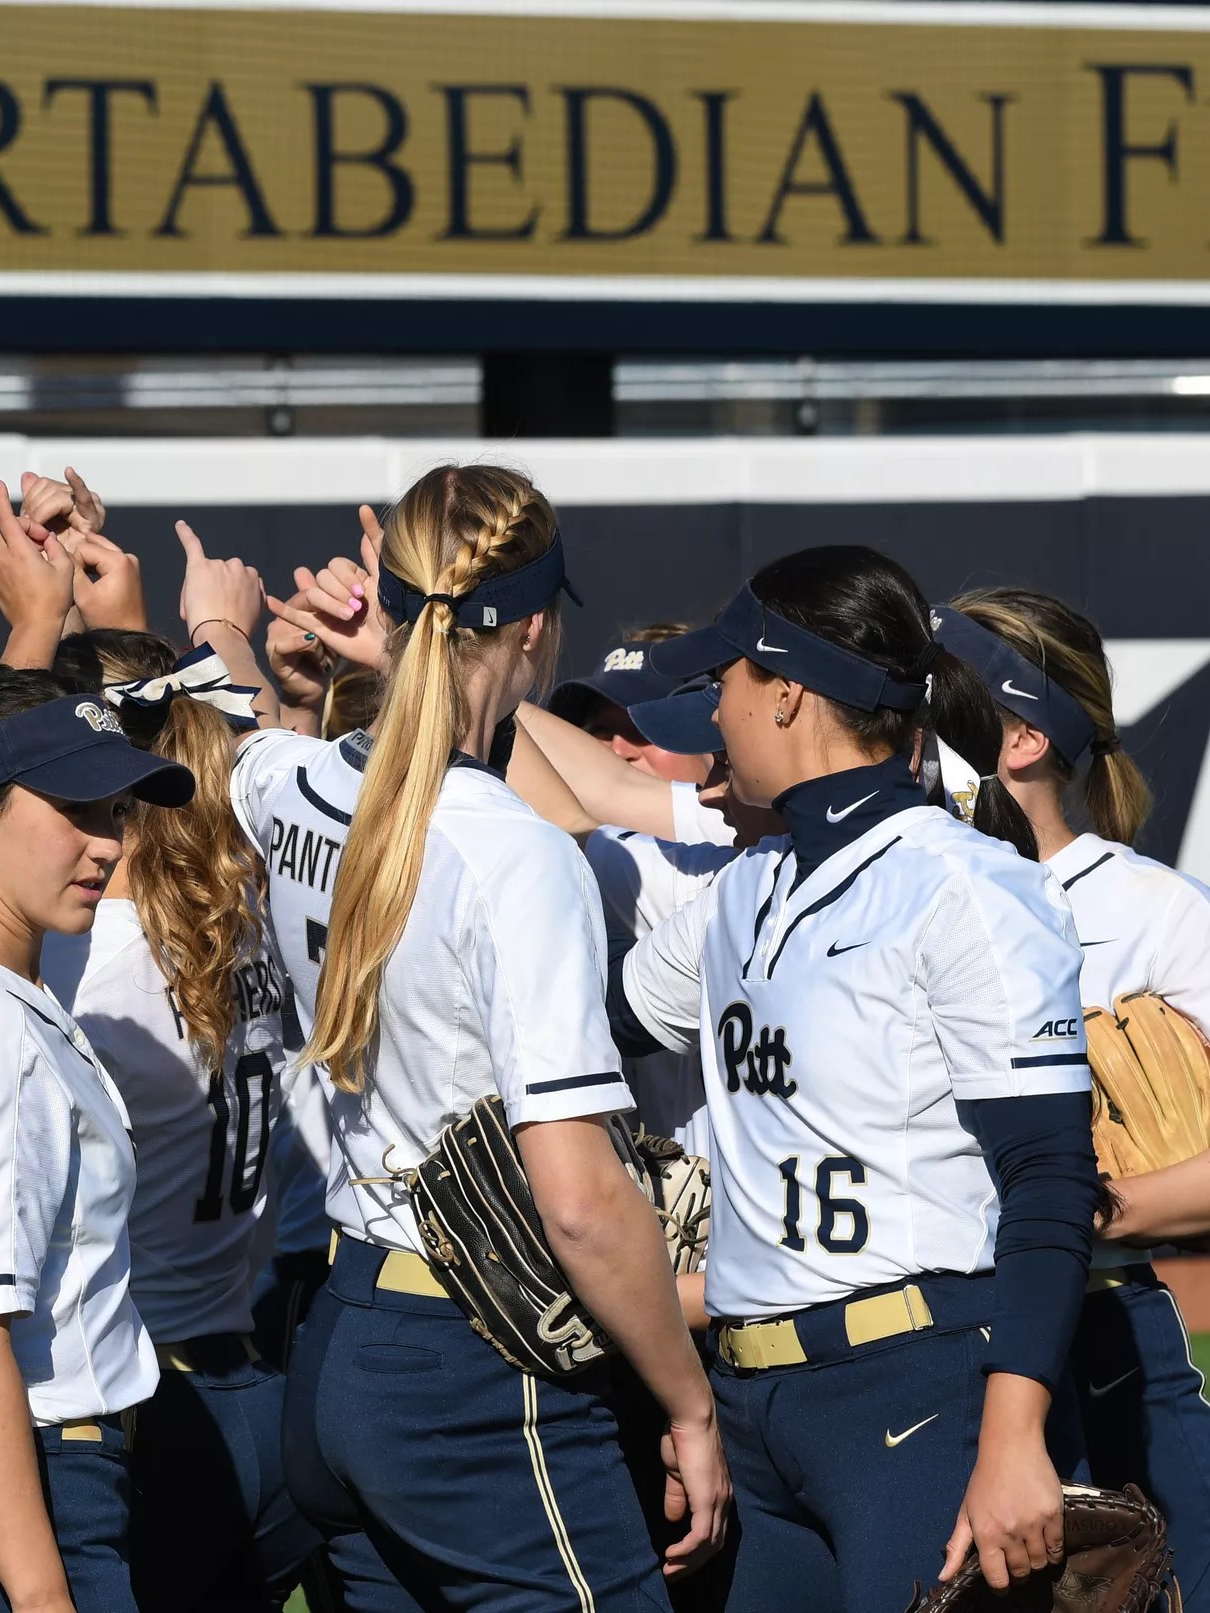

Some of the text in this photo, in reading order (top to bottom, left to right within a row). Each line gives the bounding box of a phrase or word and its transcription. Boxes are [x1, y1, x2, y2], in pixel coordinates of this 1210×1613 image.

[1080, 62, 1210, 250] F
[604, 648, 645, 673] Pitt
[269, 817, 343, 896] PANT
[718, 1000, 798, 1100] Pitt
[1031, 1018, 1078, 1040] ACC
[194, 1052, 273, 1222] 10
[776, 1154, 872, 1257] 16
